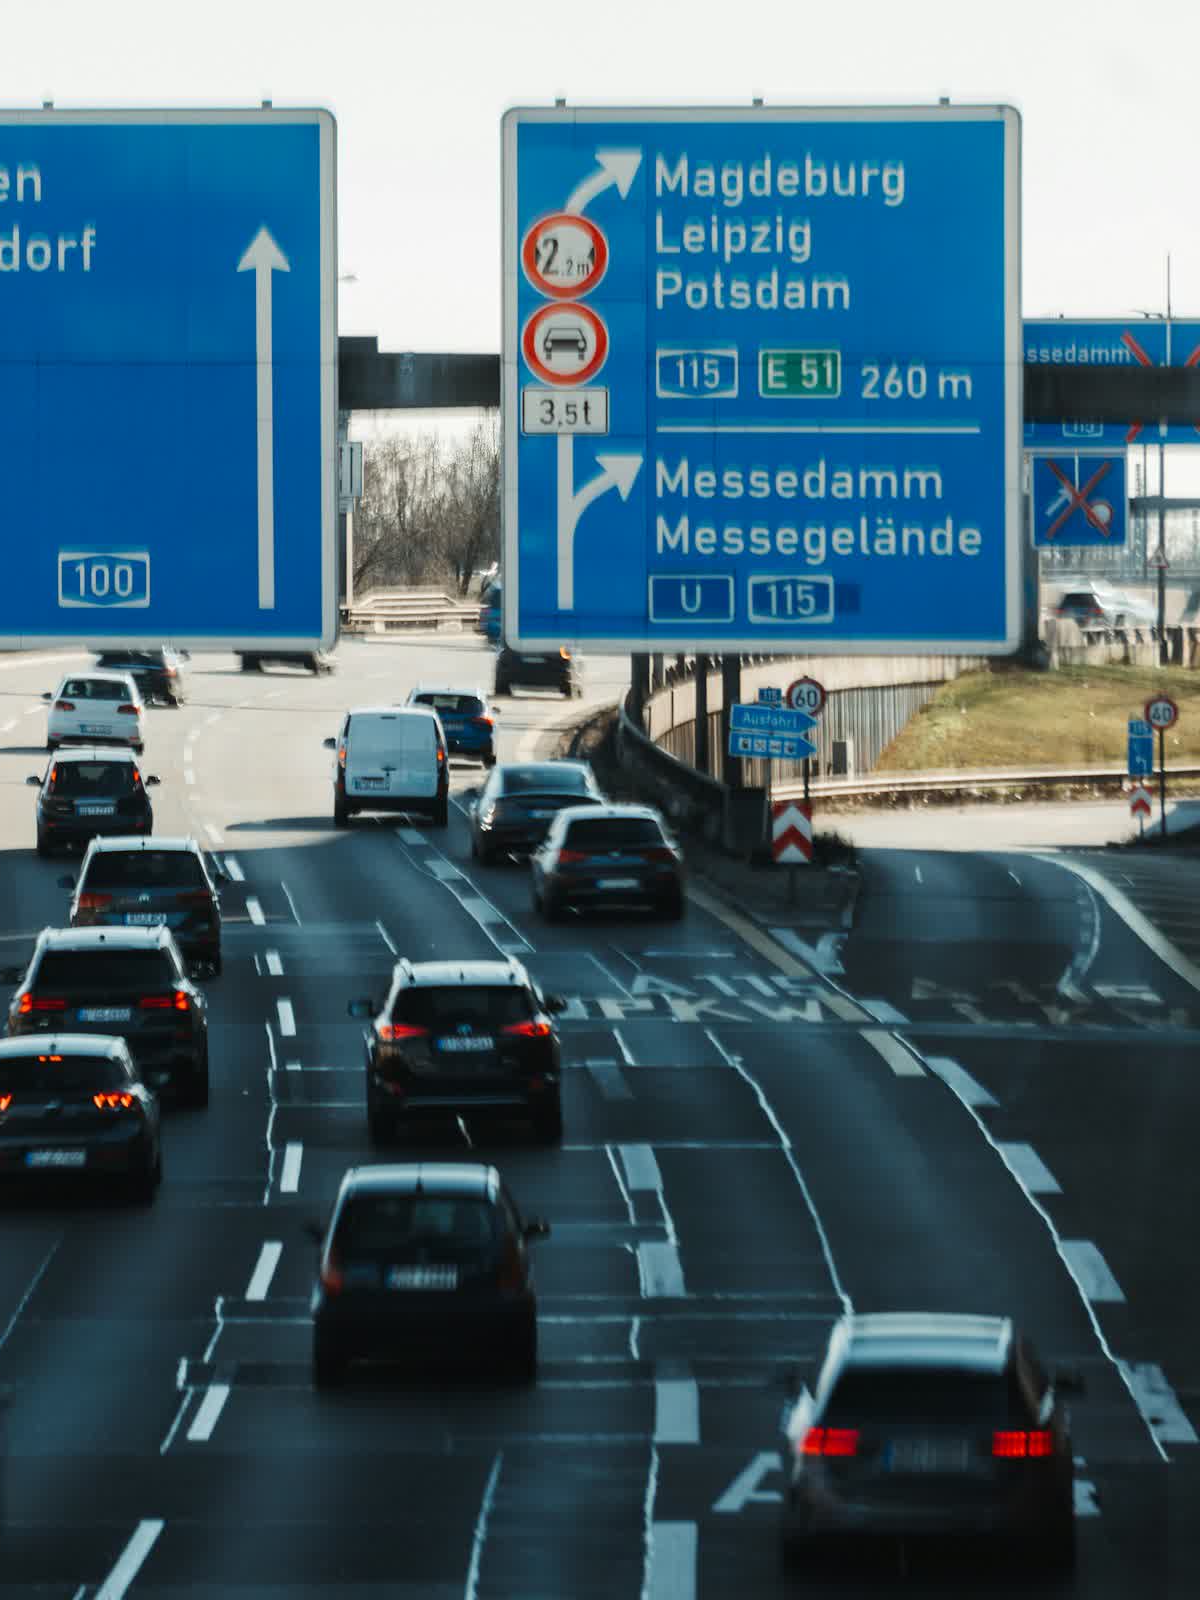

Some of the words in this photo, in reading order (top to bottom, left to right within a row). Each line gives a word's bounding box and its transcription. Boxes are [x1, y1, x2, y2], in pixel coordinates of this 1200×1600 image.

[655, 153, 905, 207] Magdeburg
[655, 212, 812, 264] Leipzig
[655, 270, 850, 310] Potsdam
[1023, 343, 1131, 364] ssedamm
[675, 358, 721, 390] 115
[767, 357, 787, 389] E
[801, 356, 834, 389] 51
[861, 366, 927, 399] 260
[938, 373, 973, 399] m
[655, 457, 943, 499] Messedamm
[655, 515, 982, 565] Messegelände
[73, 563, 134, 598] 100
[680, 583, 702, 613] U
[766, 583, 816, 616] 115
[795, 689, 818, 708] 60
